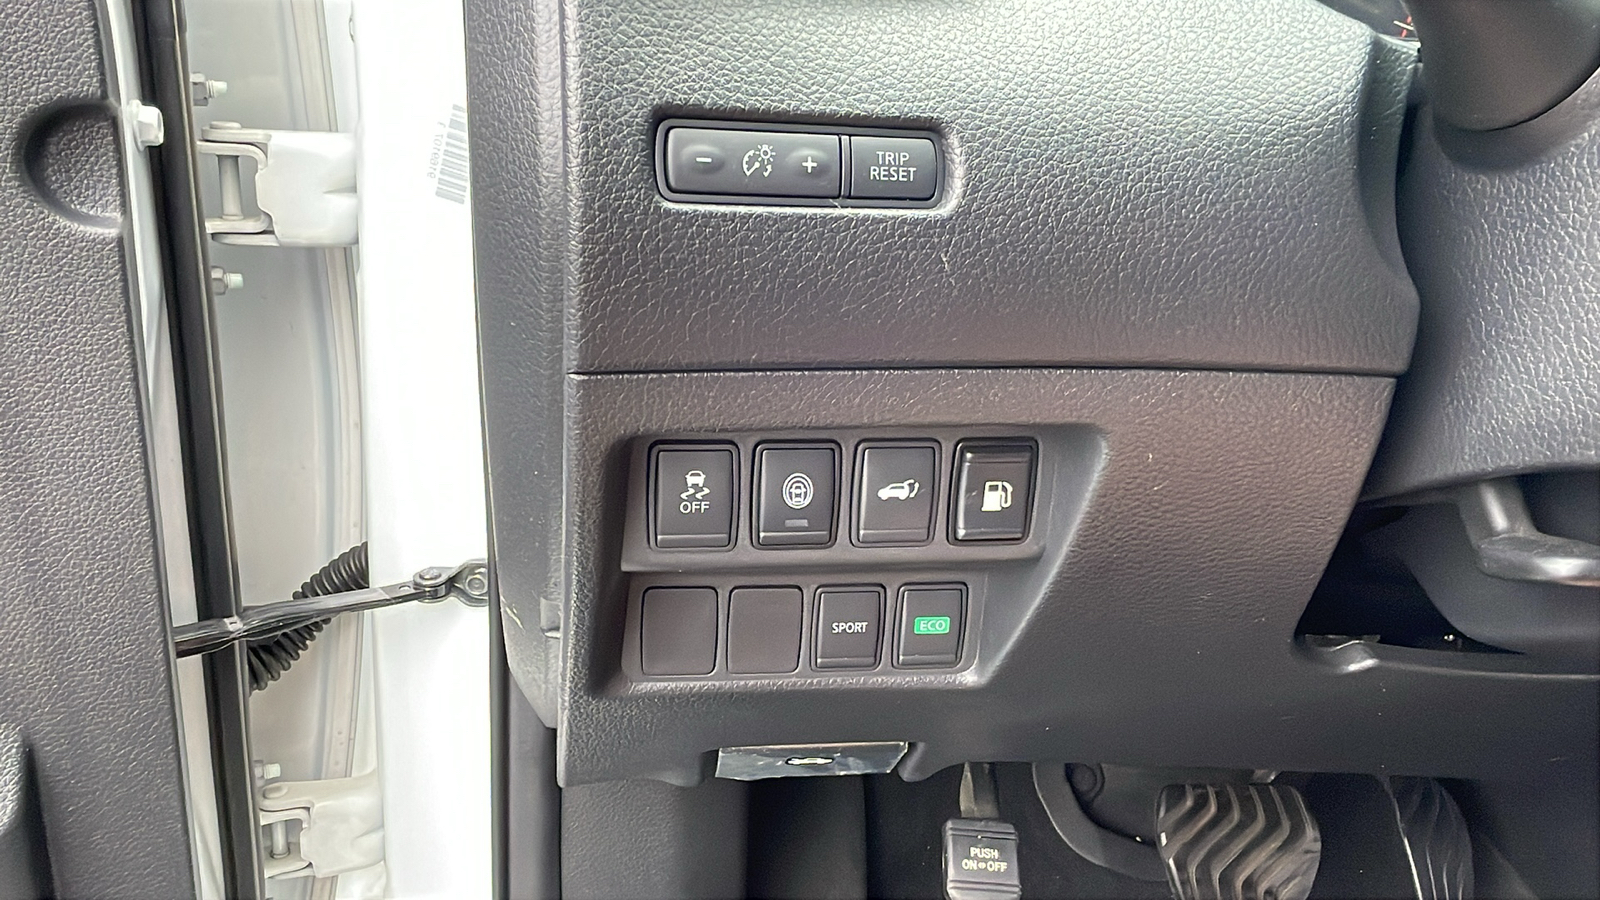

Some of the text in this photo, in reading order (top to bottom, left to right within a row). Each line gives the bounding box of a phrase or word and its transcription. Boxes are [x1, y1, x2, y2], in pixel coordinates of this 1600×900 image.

[875, 151, 910, 166] TRIP
[870, 166, 917, 182] RESET
[679, 501, 711, 514] OFF
[831, 621, 869, 634] SPORT
[919, 620, 946, 631] ECO
[970, 846, 999, 860] PUSH
